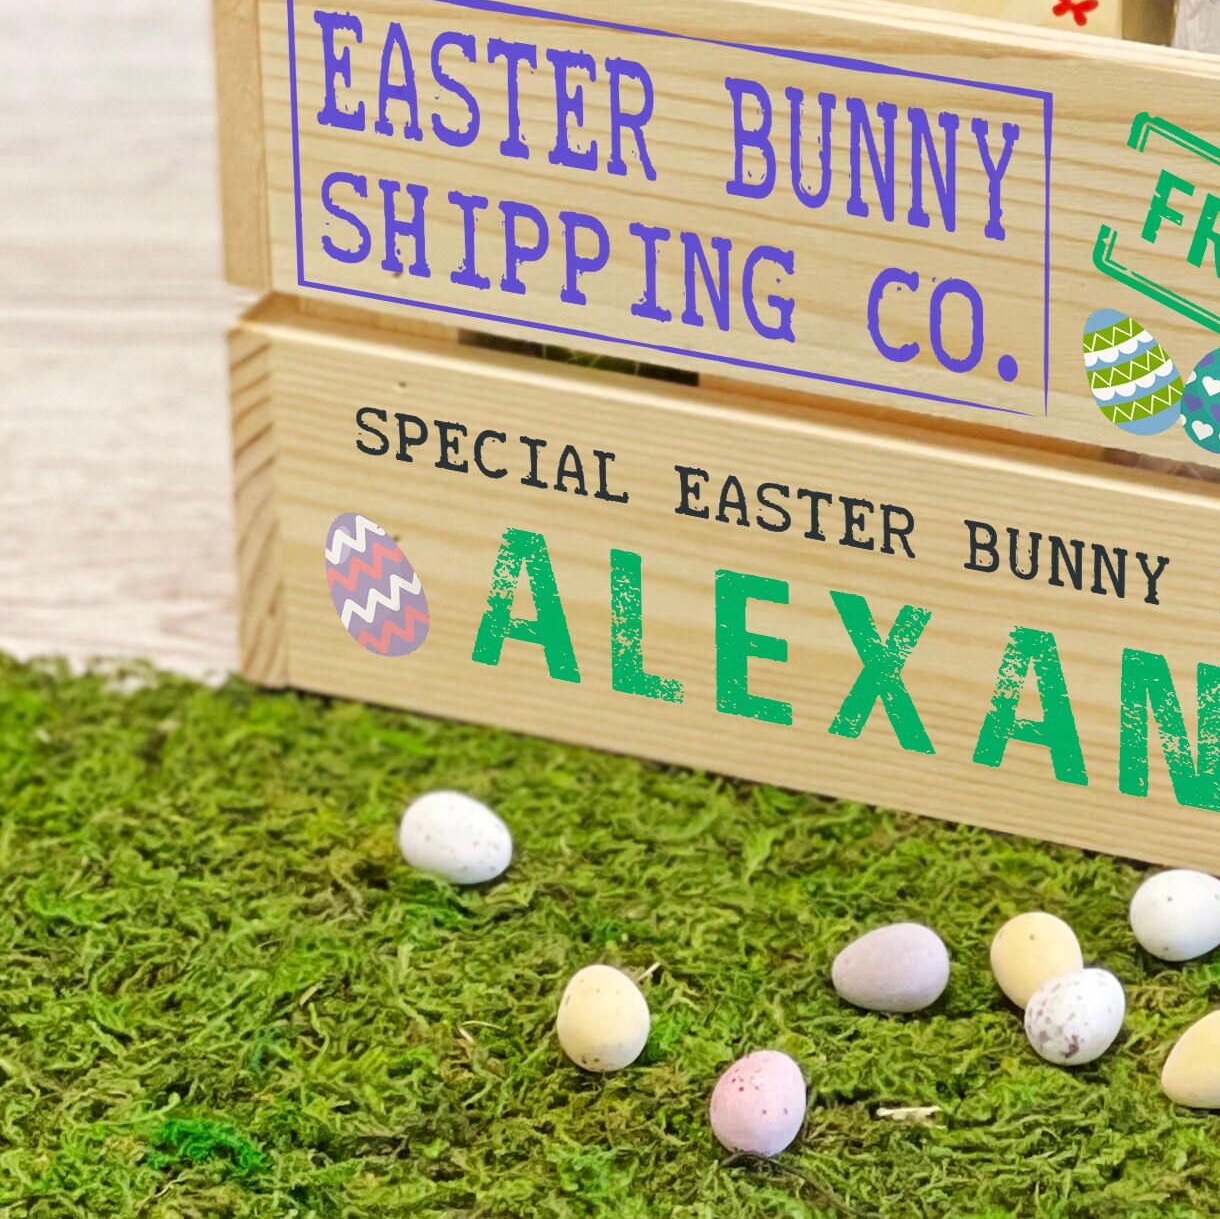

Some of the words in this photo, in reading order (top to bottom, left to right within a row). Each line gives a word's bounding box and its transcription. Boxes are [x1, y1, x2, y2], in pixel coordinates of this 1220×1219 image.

[314, 10, 657, 181] EASTER
[725, 77, 1020, 241] BUNNY
[321, 171, 795, 343] SHIPPING
[867, 267, 1019, 382] CO.
[356, 407, 629, 504] SPECIAL
[674, 465, 916, 559] EASTER
[963, 519, 1170, 606] BUNNY
